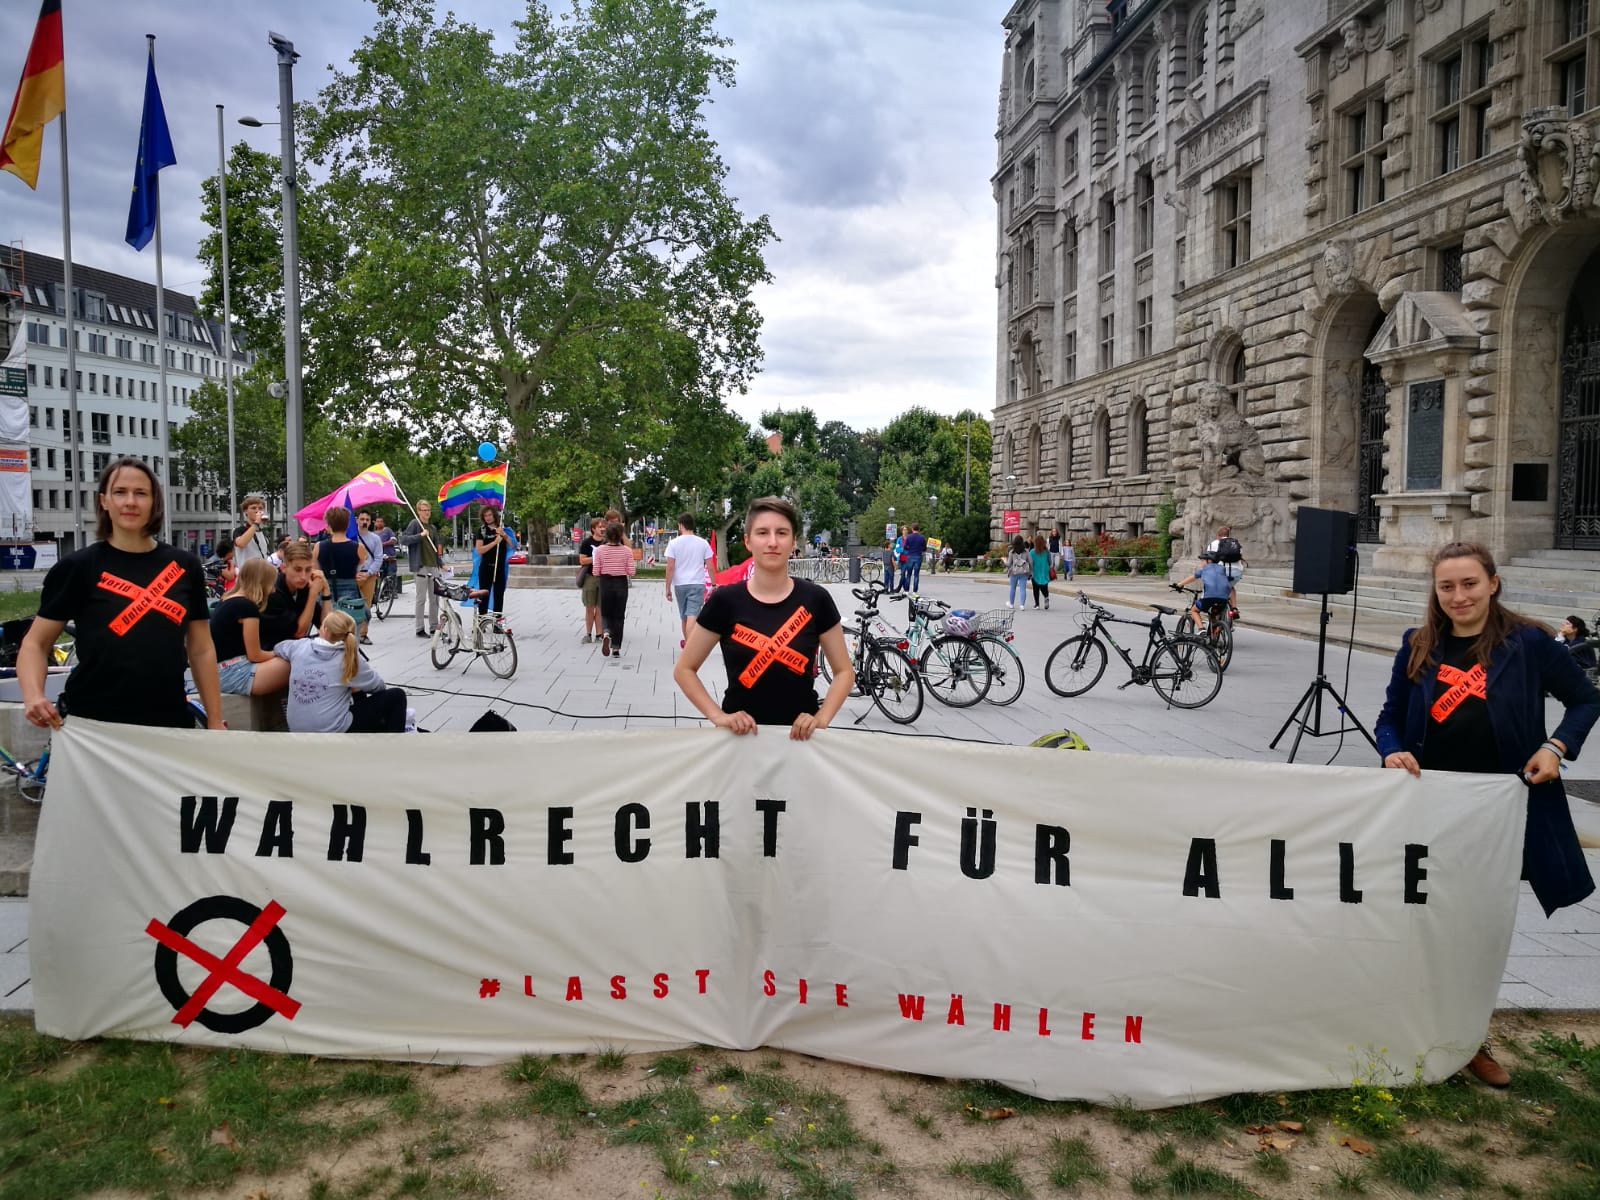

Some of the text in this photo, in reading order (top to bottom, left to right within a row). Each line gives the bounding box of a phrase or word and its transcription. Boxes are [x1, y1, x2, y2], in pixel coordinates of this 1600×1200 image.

[150, 583, 164, 598] the
[774, 631, 789, 648] the
[179, 795, 1429, 905] WAHLRECHT FÜR ALLE
[479, 969, 1143, 1044] #LASST SIE WÄHLEN
